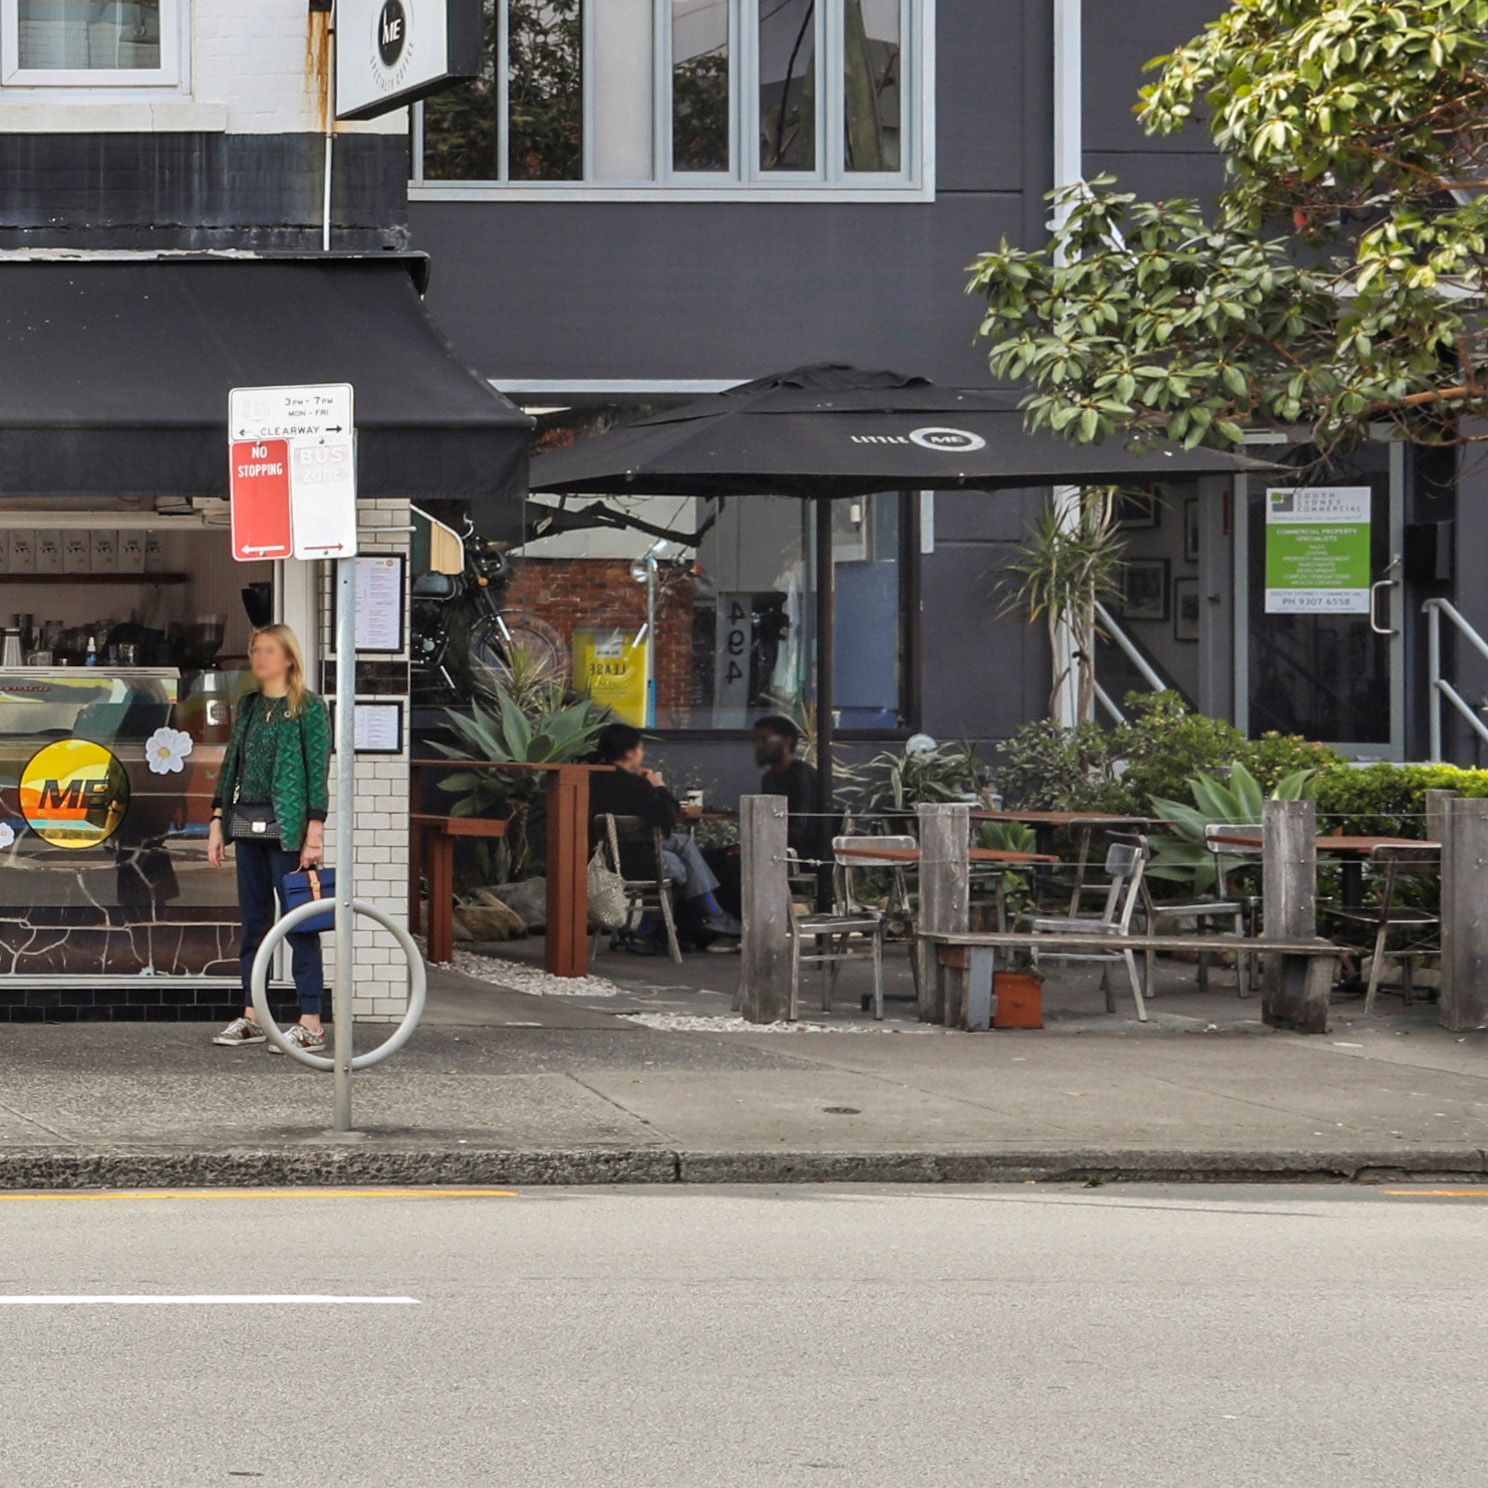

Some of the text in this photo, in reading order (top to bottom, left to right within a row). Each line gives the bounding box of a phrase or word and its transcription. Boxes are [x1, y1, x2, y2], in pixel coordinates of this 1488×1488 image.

[260, 425, 321, 436] CLEARWAY
[850, 435, 965, 444] LITTLE ME
[251, 446, 268, 459] NO
[237, 462, 283, 478] STOPPING
[38, 778, 110, 811] ME
